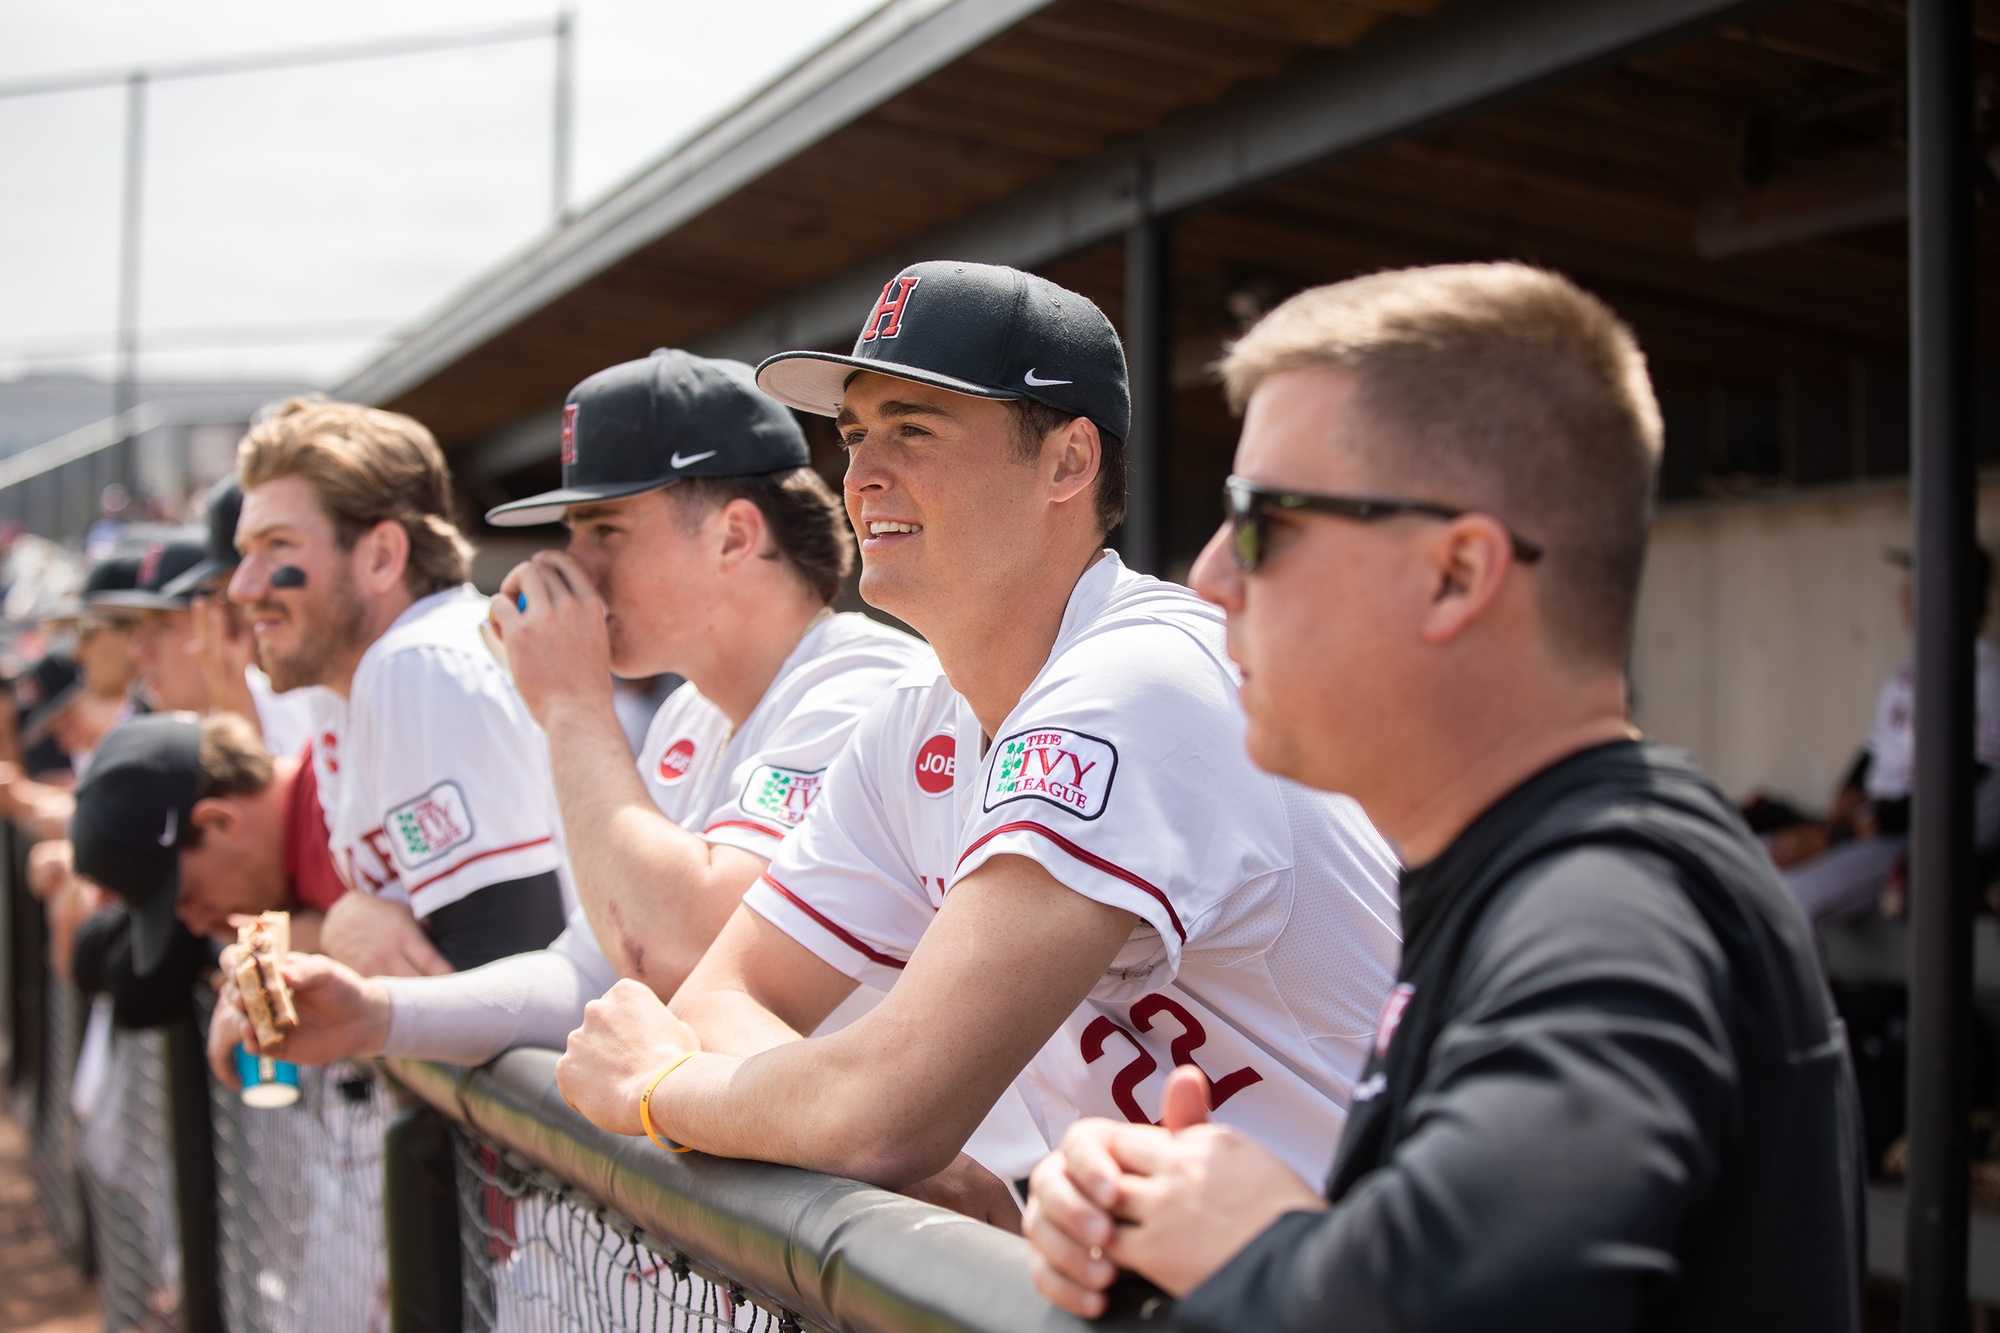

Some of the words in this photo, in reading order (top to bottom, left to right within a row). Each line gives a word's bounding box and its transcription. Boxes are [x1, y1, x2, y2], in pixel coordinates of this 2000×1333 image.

[863, 276, 921, 343] H
[1026, 734, 1062, 748] THE
[919, 752, 955, 777] JOE
[1016, 748, 1096, 790] IVY
[784, 786, 822, 810] IV
[1013, 778, 1088, 809] LEAGUE
[1080, 993, 1263, 1126] 22
